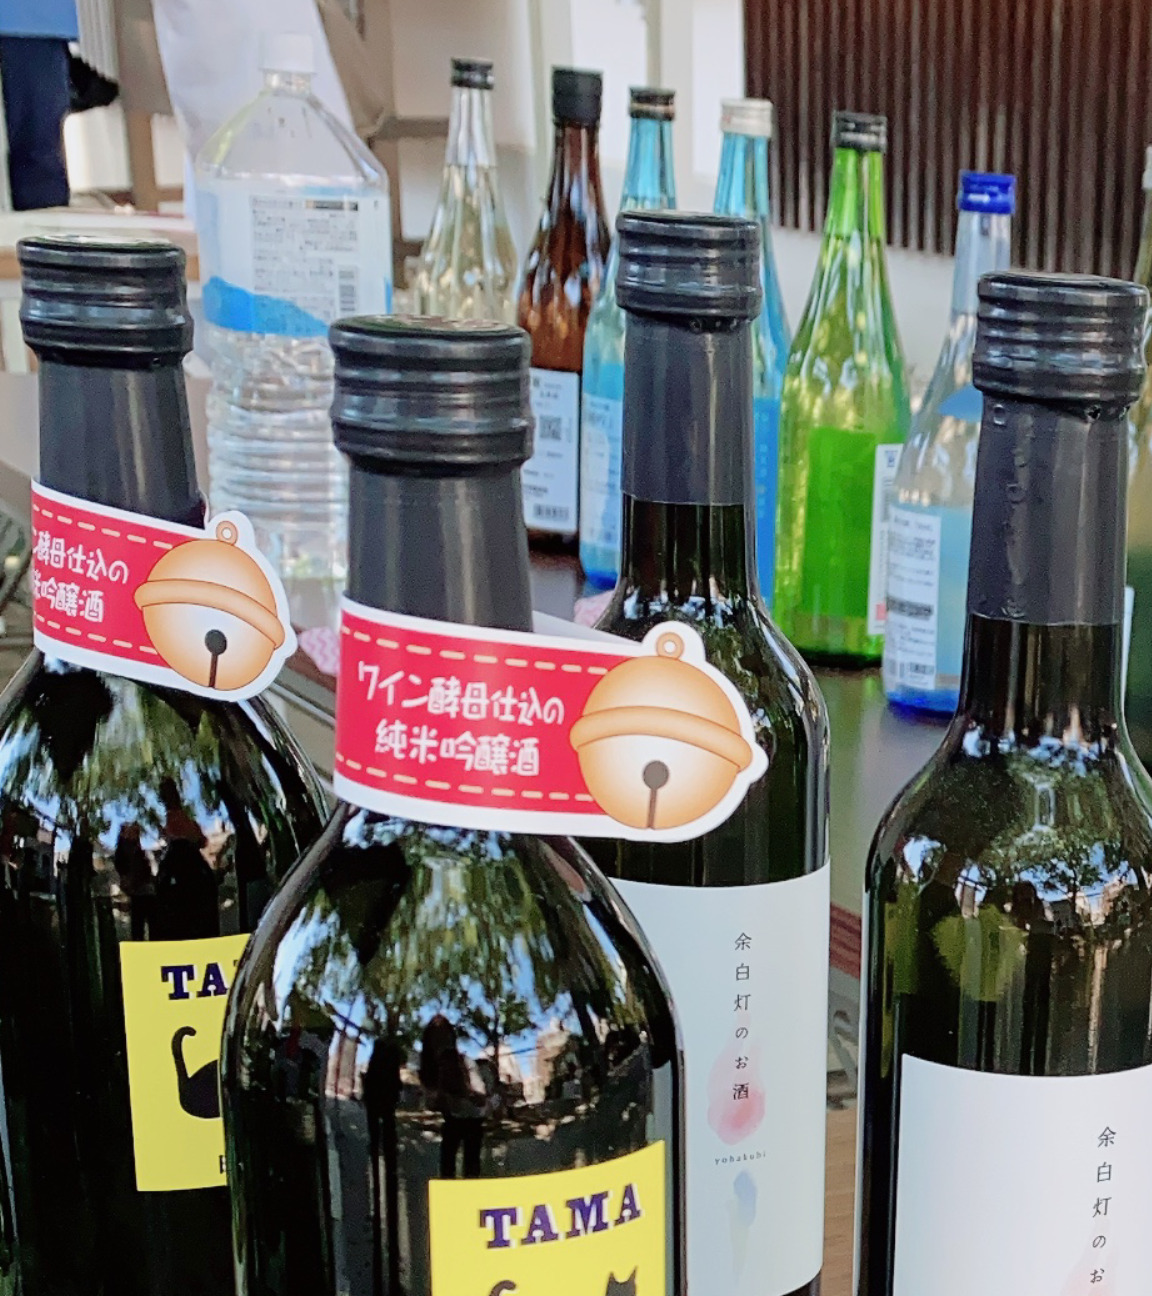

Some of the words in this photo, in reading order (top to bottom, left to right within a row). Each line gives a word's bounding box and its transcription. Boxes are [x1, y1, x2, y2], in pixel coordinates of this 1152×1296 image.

[358, 661, 565, 726] ワイン酵母仕込の
[375, 718, 540, 776] 純米吟醸酒
[160, 960, 239, 1000] TA
[732, 932, 753, 1101] 余白灯のお酒
[479, 1183, 642, 1250] TAMA
